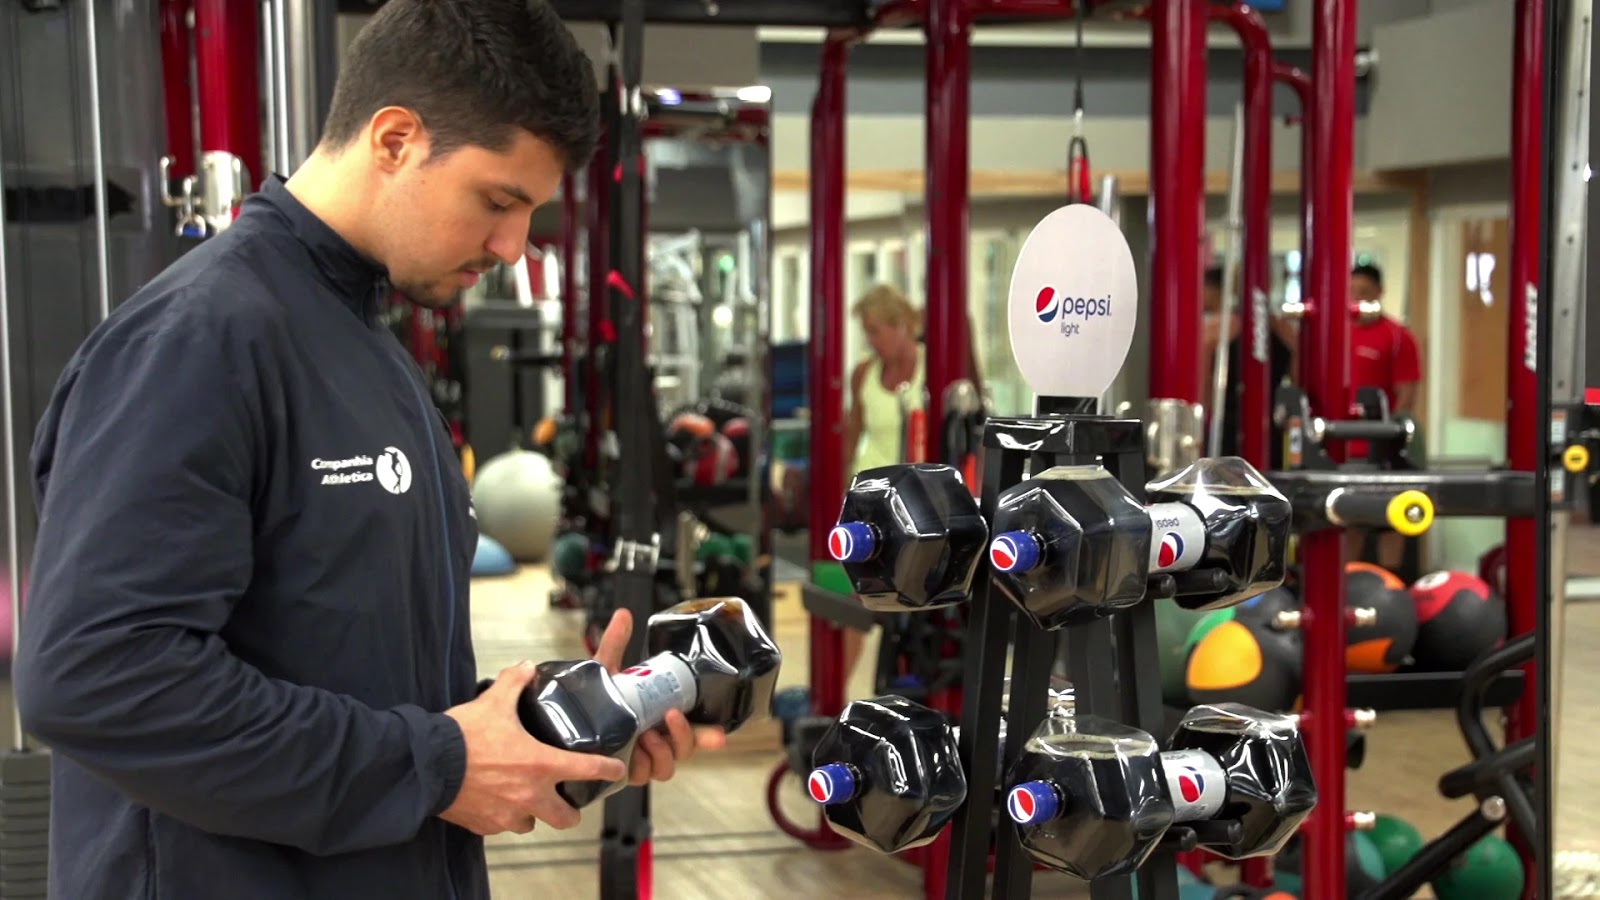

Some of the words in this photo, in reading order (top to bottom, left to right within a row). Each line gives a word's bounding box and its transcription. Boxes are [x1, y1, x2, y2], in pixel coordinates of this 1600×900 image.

[1062, 294, 1112, 321] pepsi
[1060, 322, 1080, 337] light
[321, 471, 374, 485] Athletica
